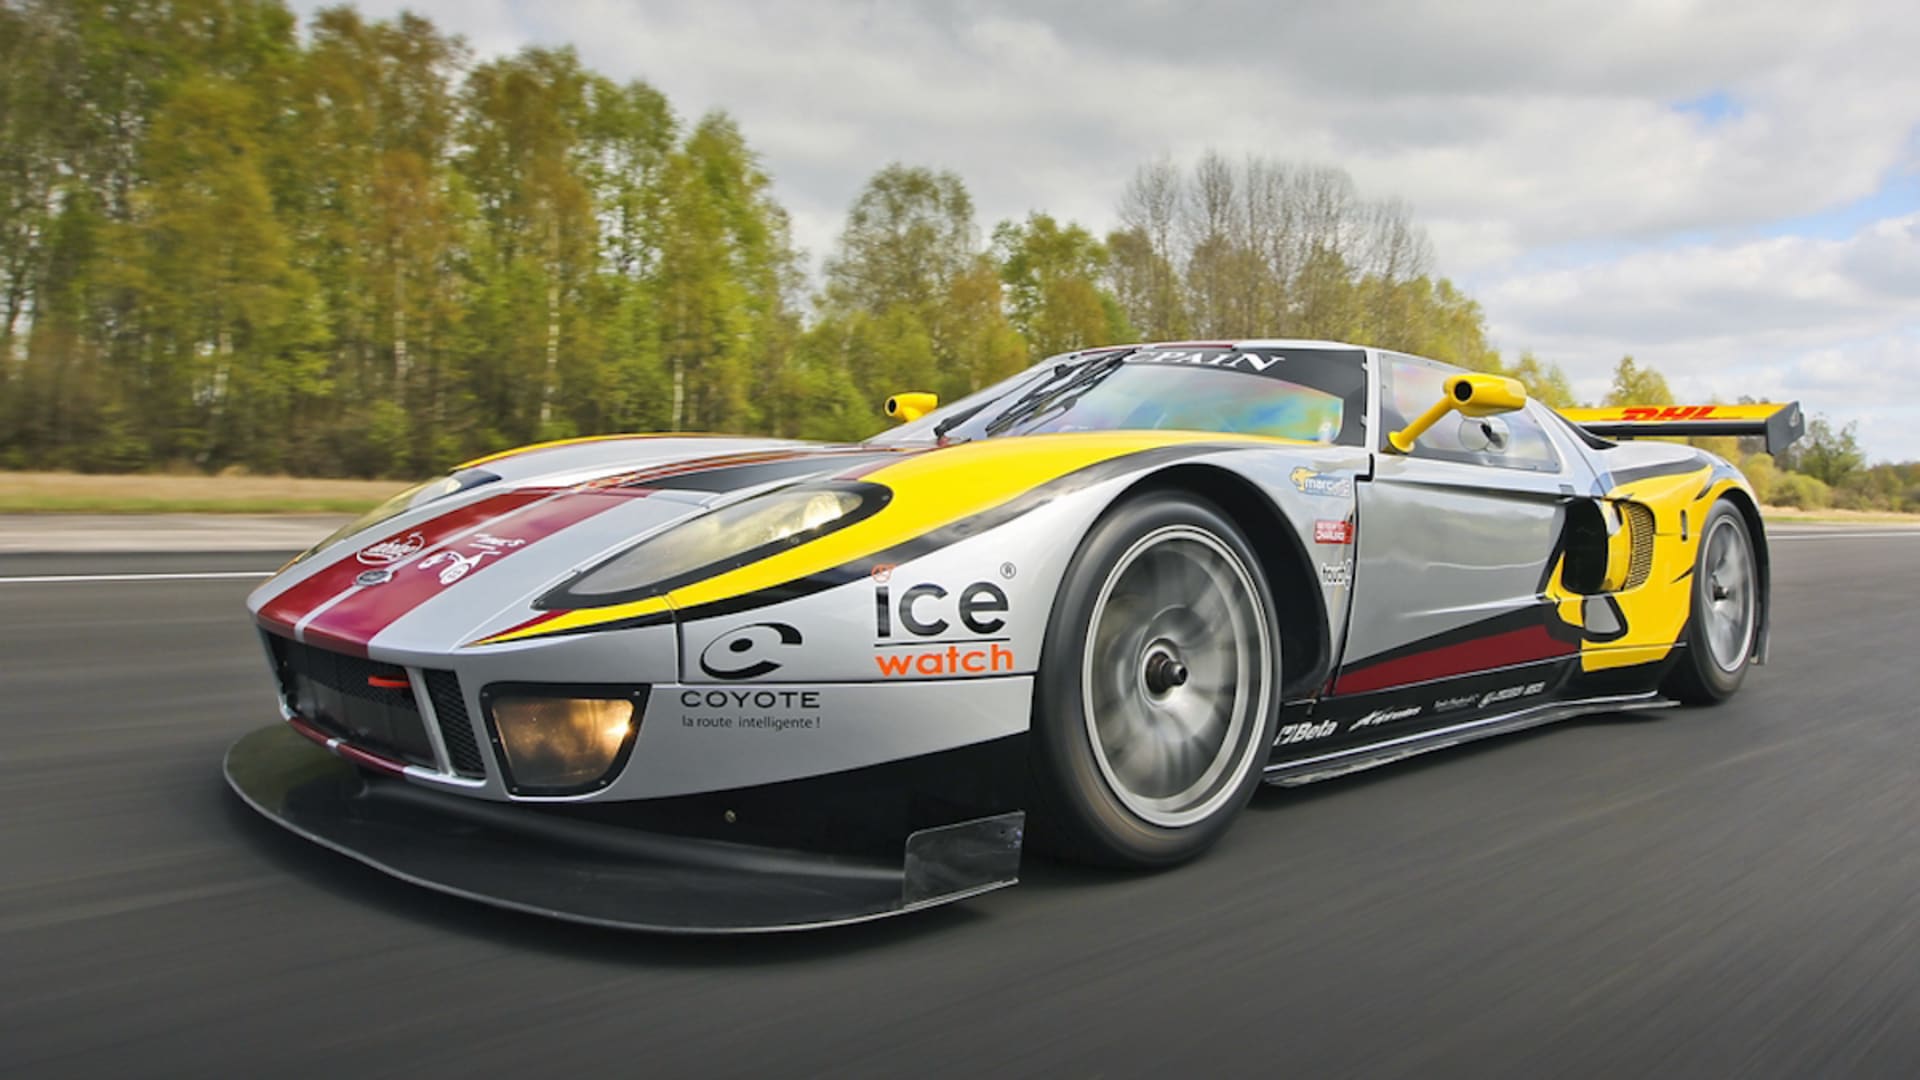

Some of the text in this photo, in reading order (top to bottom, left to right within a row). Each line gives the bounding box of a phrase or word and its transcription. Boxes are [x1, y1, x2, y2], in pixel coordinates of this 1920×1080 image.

[1620, 406, 1718, 421] DHL
[871, 563, 1010, 639] ice
[875, 643, 1014, 677] watch
[680, 690, 821, 709] COYOTE
[682, 715, 694, 728] la
[697, 717, 732, 729] route
[738, 715, 812, 731] intelligente
[1291, 720, 1338, 743] Beta
